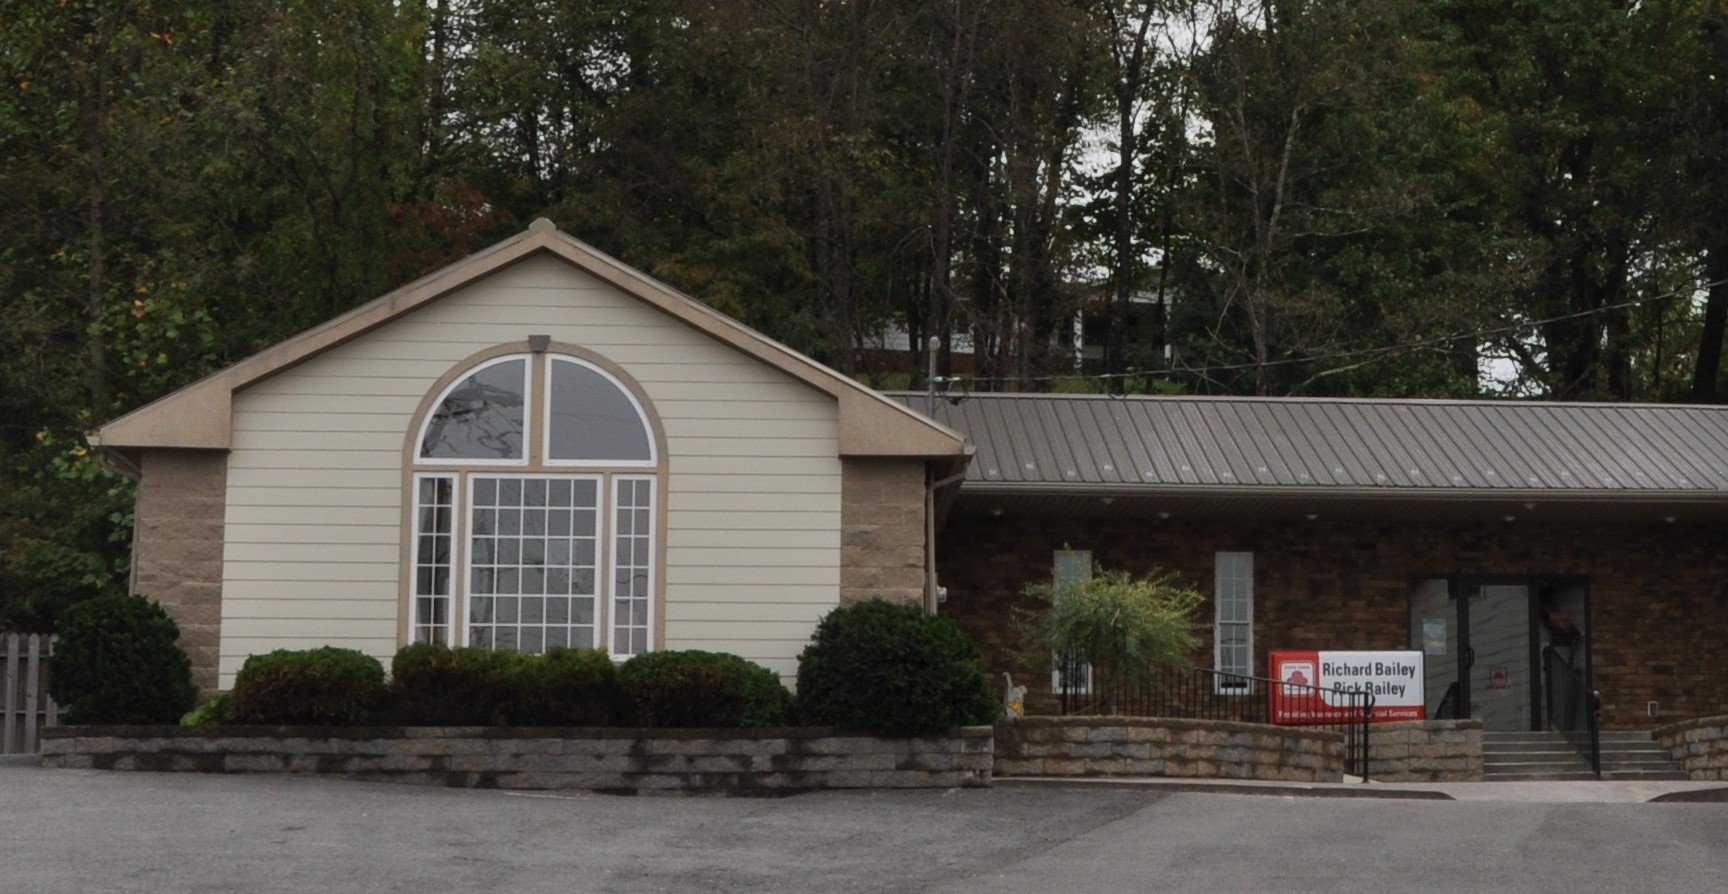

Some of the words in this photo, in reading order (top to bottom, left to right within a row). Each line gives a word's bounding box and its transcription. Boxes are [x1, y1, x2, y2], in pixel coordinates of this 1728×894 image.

[1323, 662, 1371, 676] Richard
[1375, 662, 1415, 679] Bailey
[1334, 682, 1361, 694] Rick
[1365, 681, 1405, 698] Bailey
